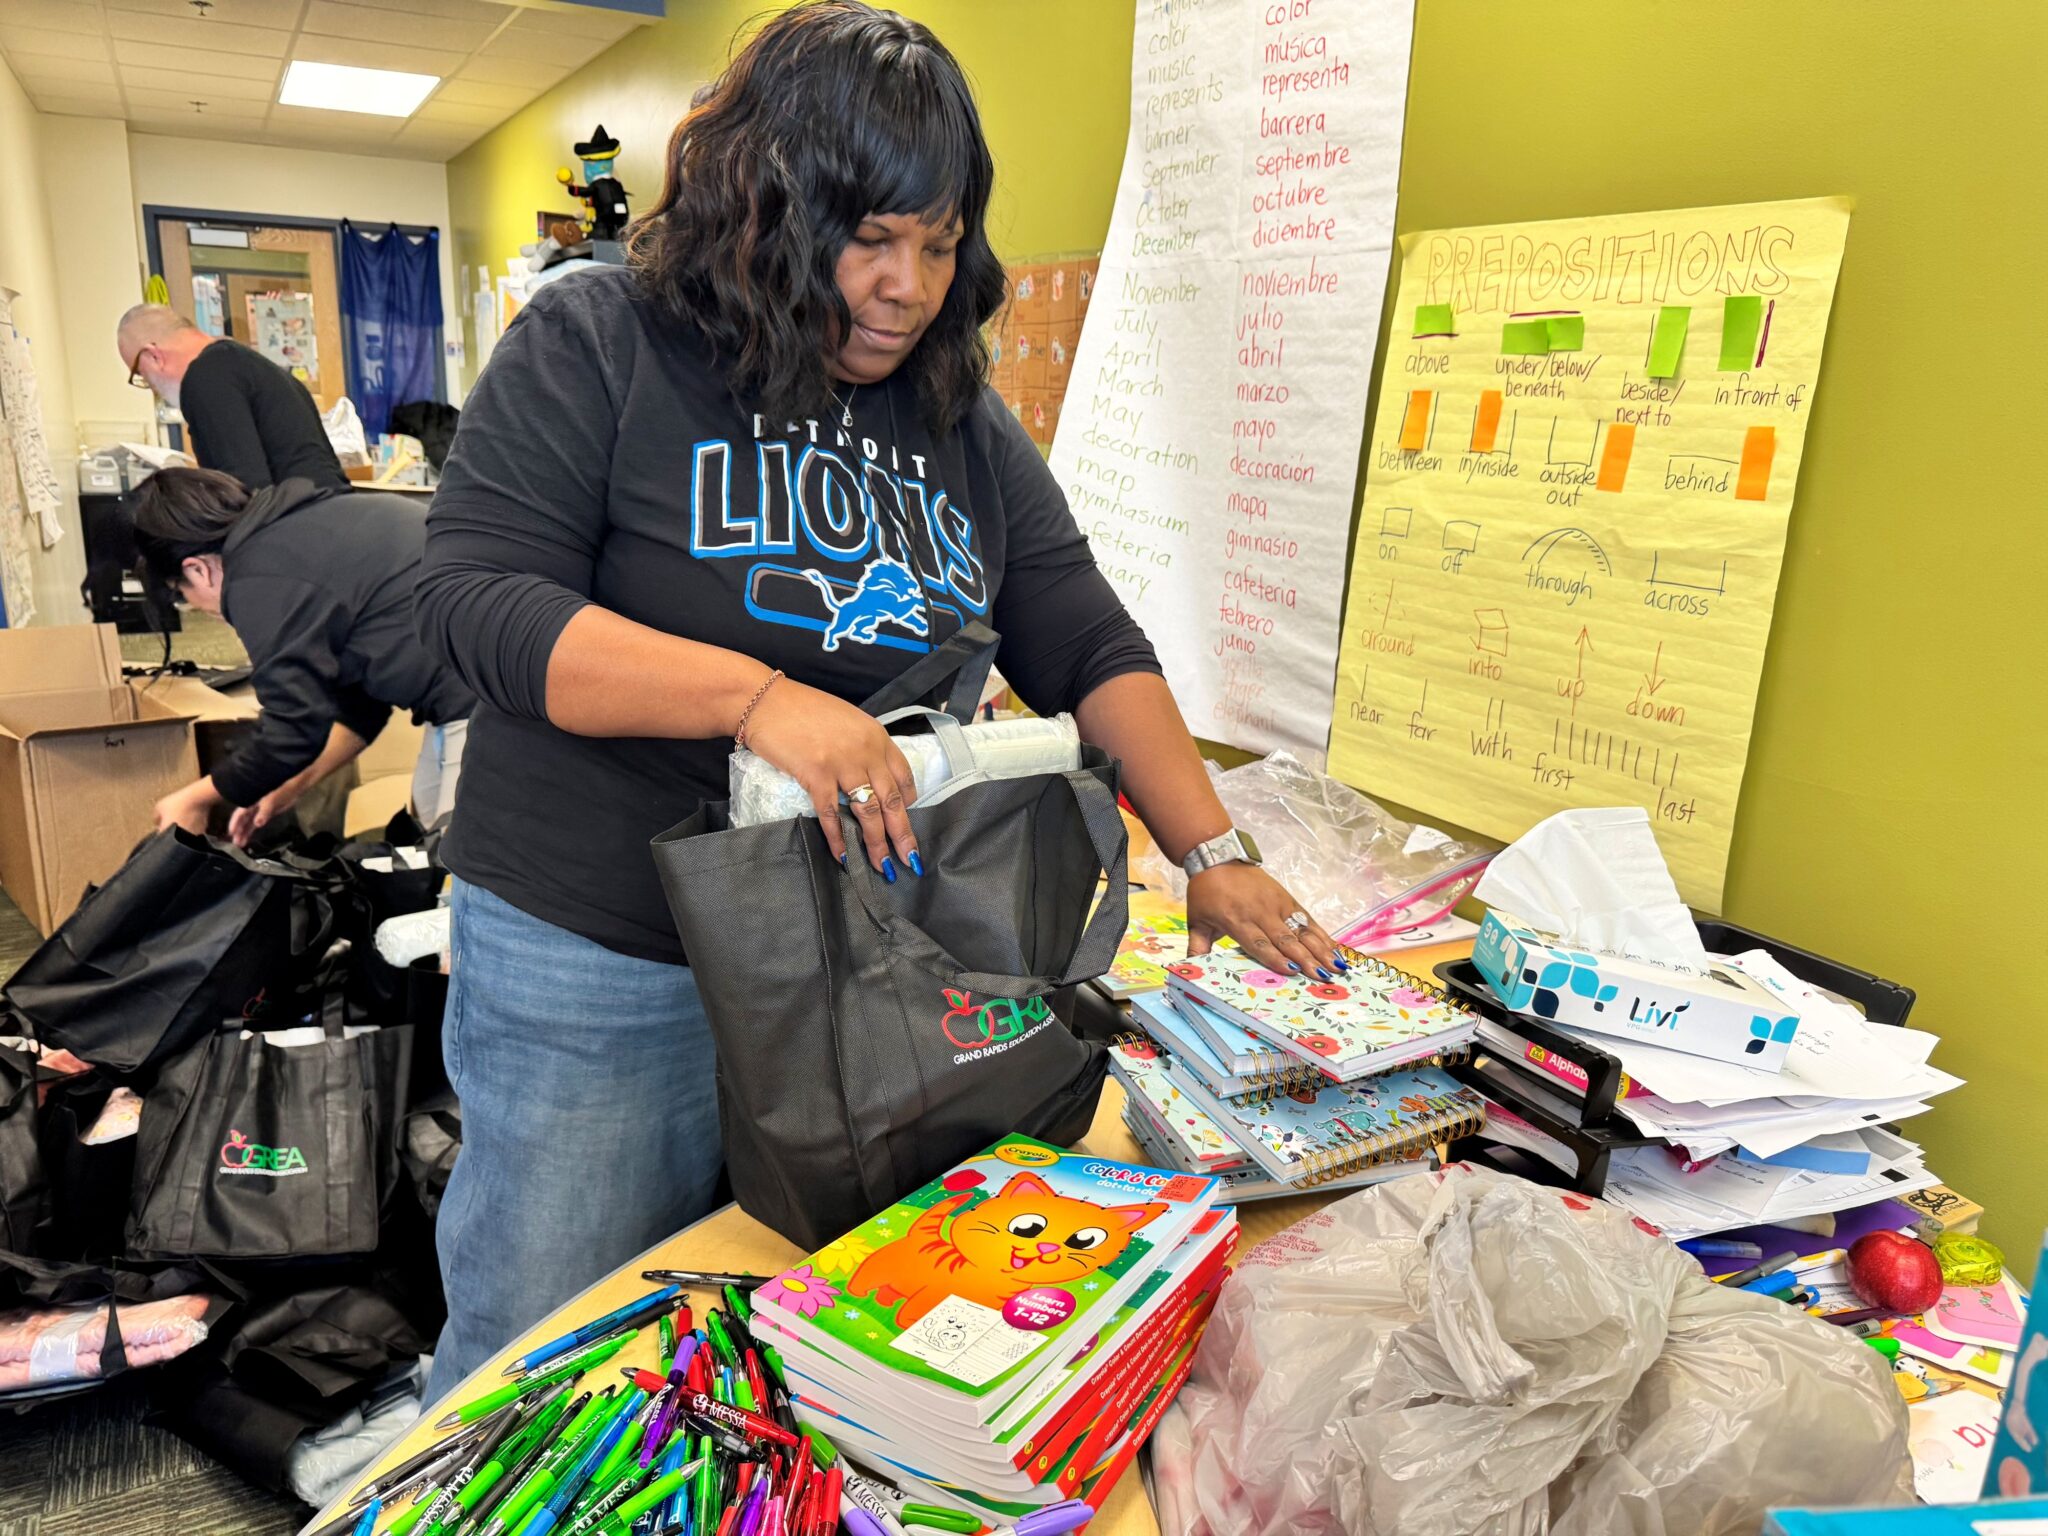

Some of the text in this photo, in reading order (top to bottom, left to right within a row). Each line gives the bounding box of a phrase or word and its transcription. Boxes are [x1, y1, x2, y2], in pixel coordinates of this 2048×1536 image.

[1266, 0, 1311, 26] color
[1148, 24, 1190, 54] color
[1265, 33, 1327, 63] música
[1148, 55, 1196, 84] music
[1262, 56, 1349, 103] representa
[1146, 73, 1224, 124] represents
[1260, 107, 1325, 138] barrera
[1142, 150, 1220, 192] September
[1256, 141, 1351, 181] septiembre
[1136, 192, 1192, 228] October
[1253, 178, 1328, 214] octubre
[1133, 225, 1200, 257] December
[1253, 215, 1336, 249] diciembre
[1242, 256, 1338, 297] noviembre
[1425, 226, 1795, 314] PREPOSITIONS
[1122, 272, 1200, 305] November
[1115, 309, 1158, 348] July
[1236, 302, 1283, 341] julio
[1104, 339, 1162, 373] April
[1238, 333, 1283, 369] abril
[1405, 351, 1450, 374] above
[1098, 367, 1164, 397] March
[1237, 383, 1289, 404] marzo
[1505, 377, 1566, 400] beneath
[1731, 377, 1780, 407] front
[1785, 383, 1806, 412] of
[1091, 395, 1144, 437] May
[1615, 404, 1672, 426] next to
[1082, 422, 1198, 475] decoration
[1233, 418, 1276, 451] mayo
[1230, 445, 1315, 483] decoración
[1378, 441, 1442, 471] between
[1458, 450, 1520, 483] in/inside
[1076, 455, 1135, 500] map
[1540, 465, 1597, 486] outside
[1664, 459, 1729, 493] behind
[1069, 483, 1190, 537] gymnasium
[1227, 492, 1268, 524] mapa
[1546, 485, 1583, 507] out
[690, 439, 988, 616] LIONS
[1225, 528, 1298, 559] gimnasio
[1378, 543, 1398, 561] on
[1441, 550, 1468, 576] off
[1224, 564, 1297, 609] cafeteria
[1524, 570, 1592, 606] through
[1644, 589, 1710, 616] across
[1219, 594, 1274, 636] febrero
[1214, 628, 1256, 657] junio
[1361, 626, 1416, 657] around
[1469, 656, 1502, 681] into
[1350, 701, 1385, 726] near
[1558, 678, 1586, 716] up
[1625, 686, 1686, 727] down
[1406, 711, 1438, 742] far
[1531, 752, 1576, 791] first
[1656, 786, 1697, 824] last
[953, 1025, 1042, 1065] GRAND RAPIDS EDUCATION
[1549, 1054, 1588, 1081] Alphab
[241, 1144, 307, 1170] GREA
[1008, 1146, 1051, 1160] Crayola
[1014, 1295, 1068, 1318] Numbers
[1031, 1292, 1066, 1308] Learn
[1108, 1353, 1120, 1367] Color
[1123, 1337, 1137, 1351] Count
[1160, 1296, 1177, 1314] Numbers
[1116, 1367, 1128, 1380] Color
[1129, 1350, 1142, 1365] Count
[1163, 1308, 1179, 1327] Numbers
[1129, 1376, 1138, 1390] Color
[1139, 1359, 1149, 1374] Count
[708, 1400, 748, 1431] MESSA
[1119, 1408, 1130, 1422] Color
[1132, 1390, 1143, 1406] Count
[1146, 1412, 1156, 1426] Color
[1157, 1394, 1168, 1410] Count
[419, 1482, 461, 1526] MESSA
[855, 1484, 888, 1521] MESSA
